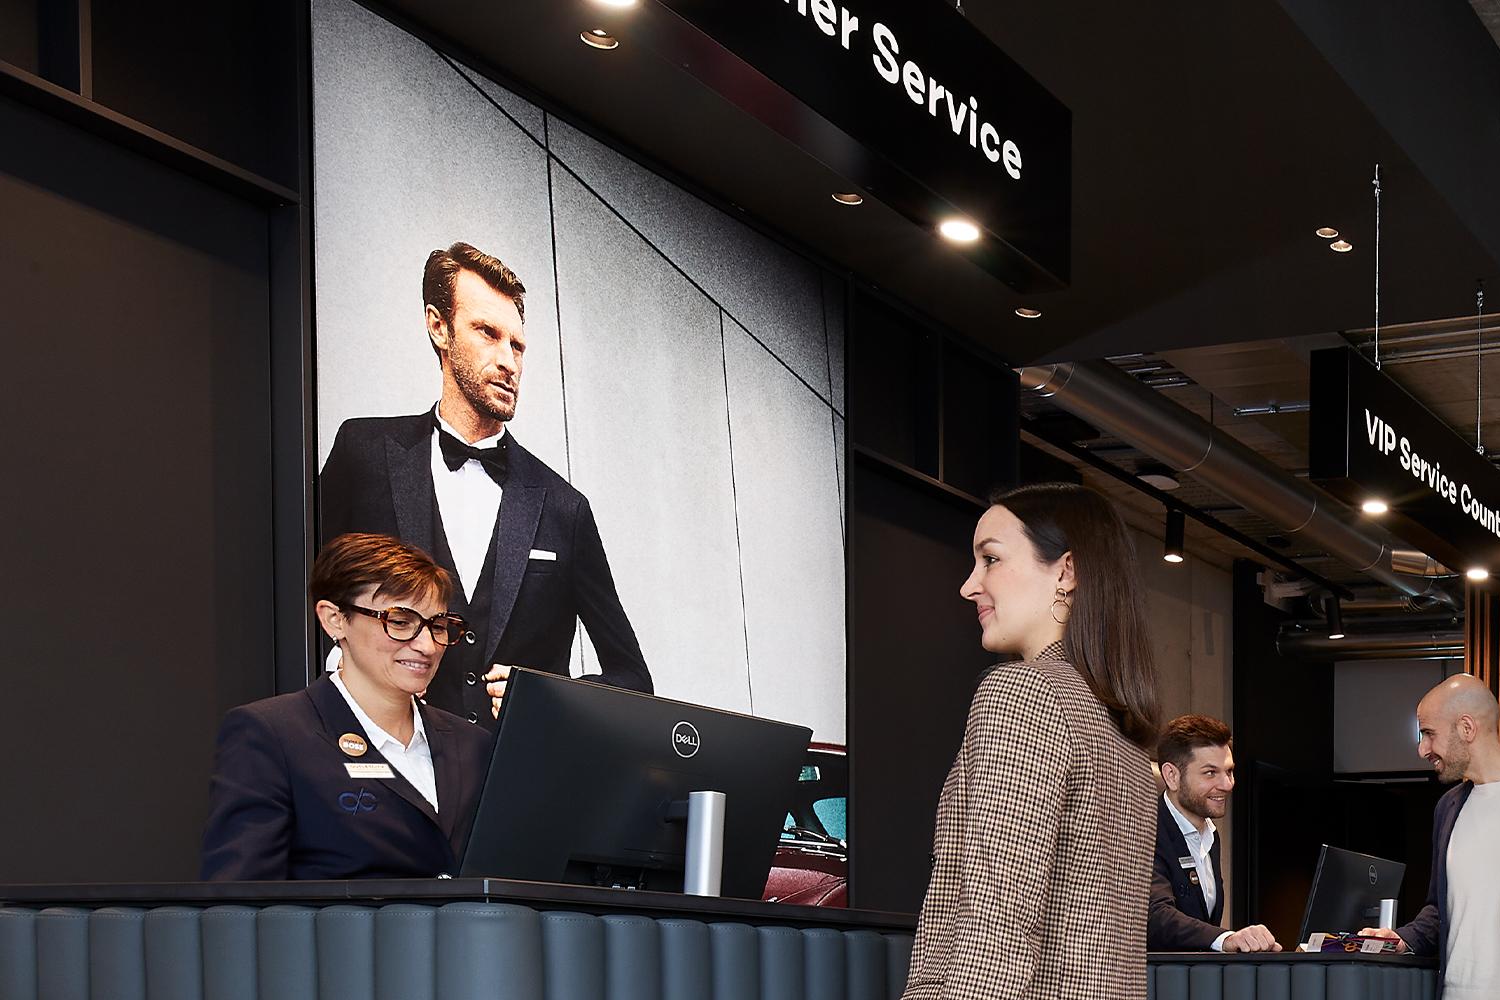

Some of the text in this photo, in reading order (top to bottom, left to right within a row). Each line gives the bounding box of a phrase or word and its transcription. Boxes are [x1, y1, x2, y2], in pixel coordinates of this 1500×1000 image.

[783, 0, 1022, 180] er Service
[1365, 408, 1396, 455] VIP
[1400, 437, 1457, 504] Service
[675, 733, 698, 746] DELL
